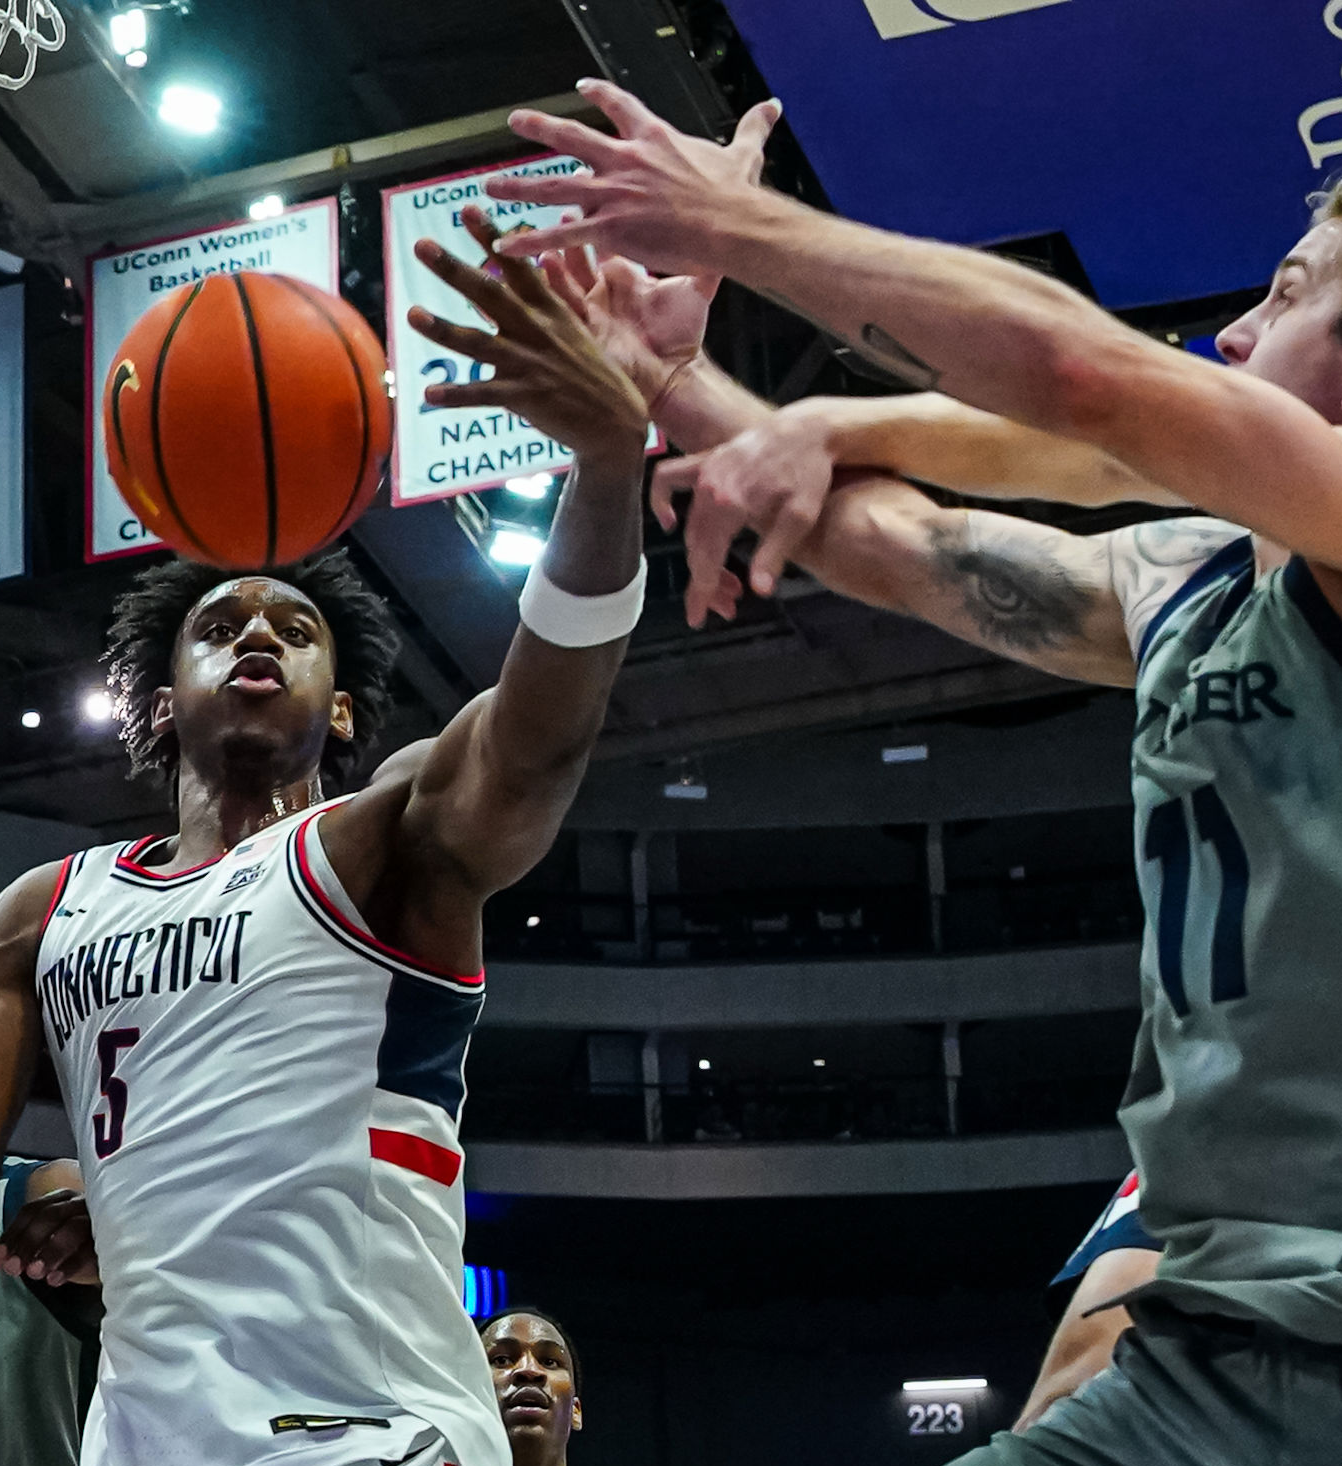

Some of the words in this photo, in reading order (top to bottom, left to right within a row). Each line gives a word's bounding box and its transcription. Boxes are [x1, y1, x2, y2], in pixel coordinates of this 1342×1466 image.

[413, 184, 487, 209] UCon
[113, 245, 190, 274] UConn
[199, 217, 307, 253] Women's
[440, 413, 530, 446] NATI
[1145, 784, 1250, 1018] 11
[93, 1027, 140, 1159] 5
[907, 1402, 964, 1435] 223
